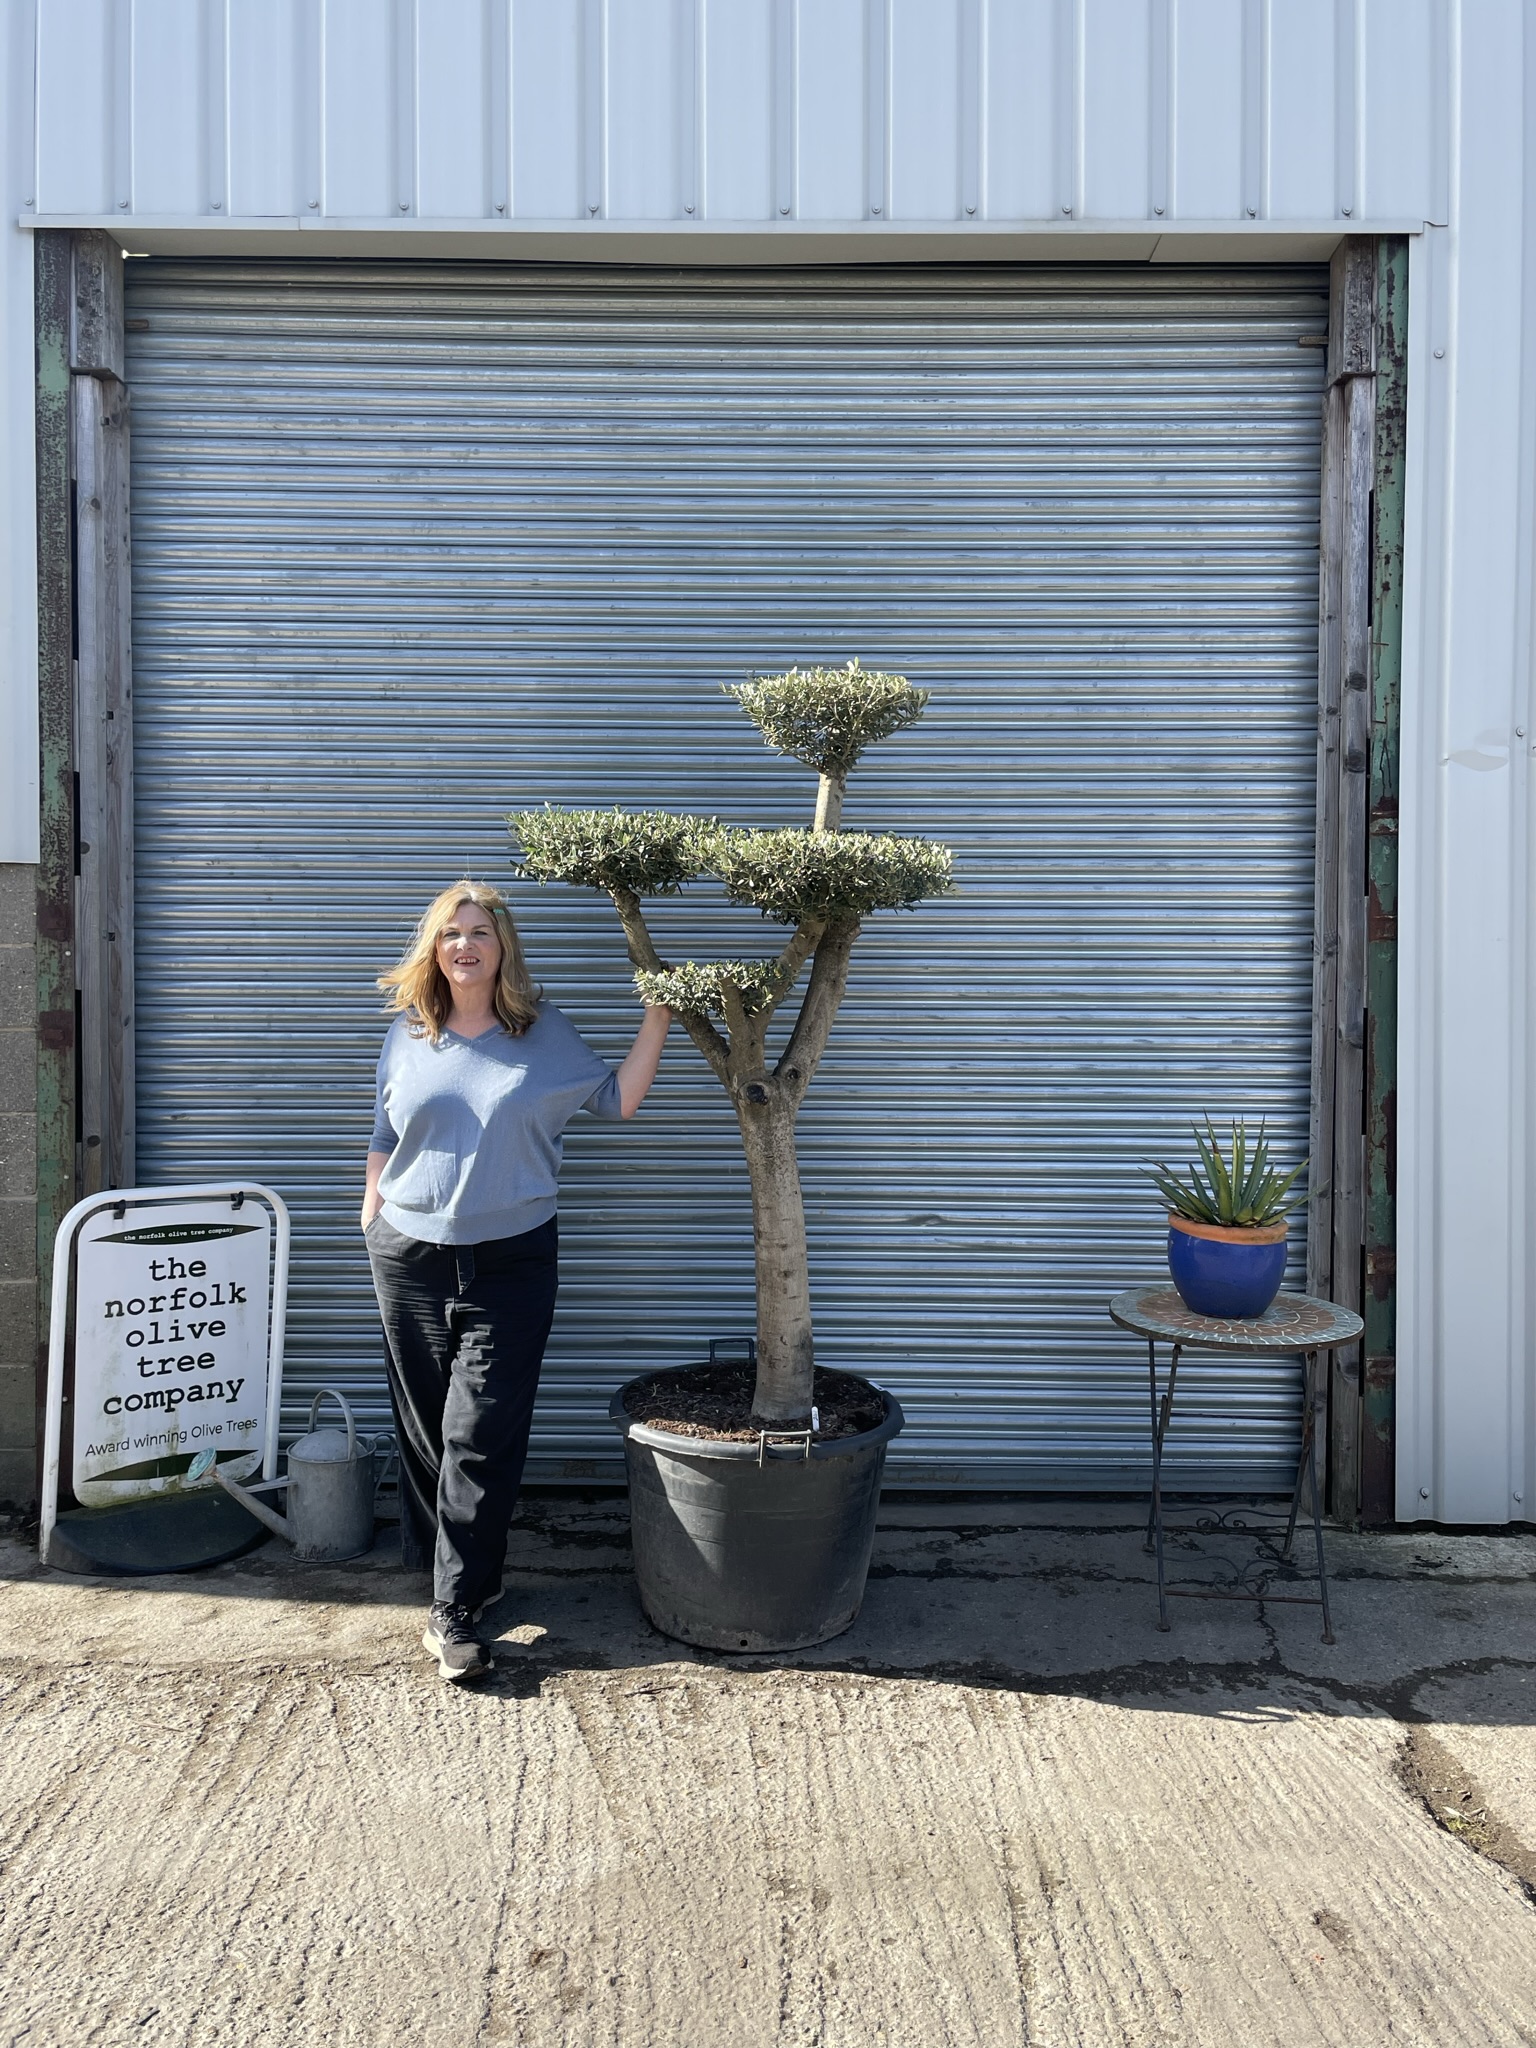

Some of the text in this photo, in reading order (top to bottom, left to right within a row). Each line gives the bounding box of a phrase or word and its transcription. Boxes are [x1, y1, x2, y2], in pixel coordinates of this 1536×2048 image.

[149, 1256, 207, 1282] the
[104, 1281, 247, 1319] norfolk
[125, 1318, 226, 1347] olive
[136, 1352, 216, 1378] tree
[103, 1377, 245, 1415] company
[85, 1437, 130, 1457] Award
[191, 1423, 223, 1438] Olive
[226, 1418, 258, 1432] Trees
